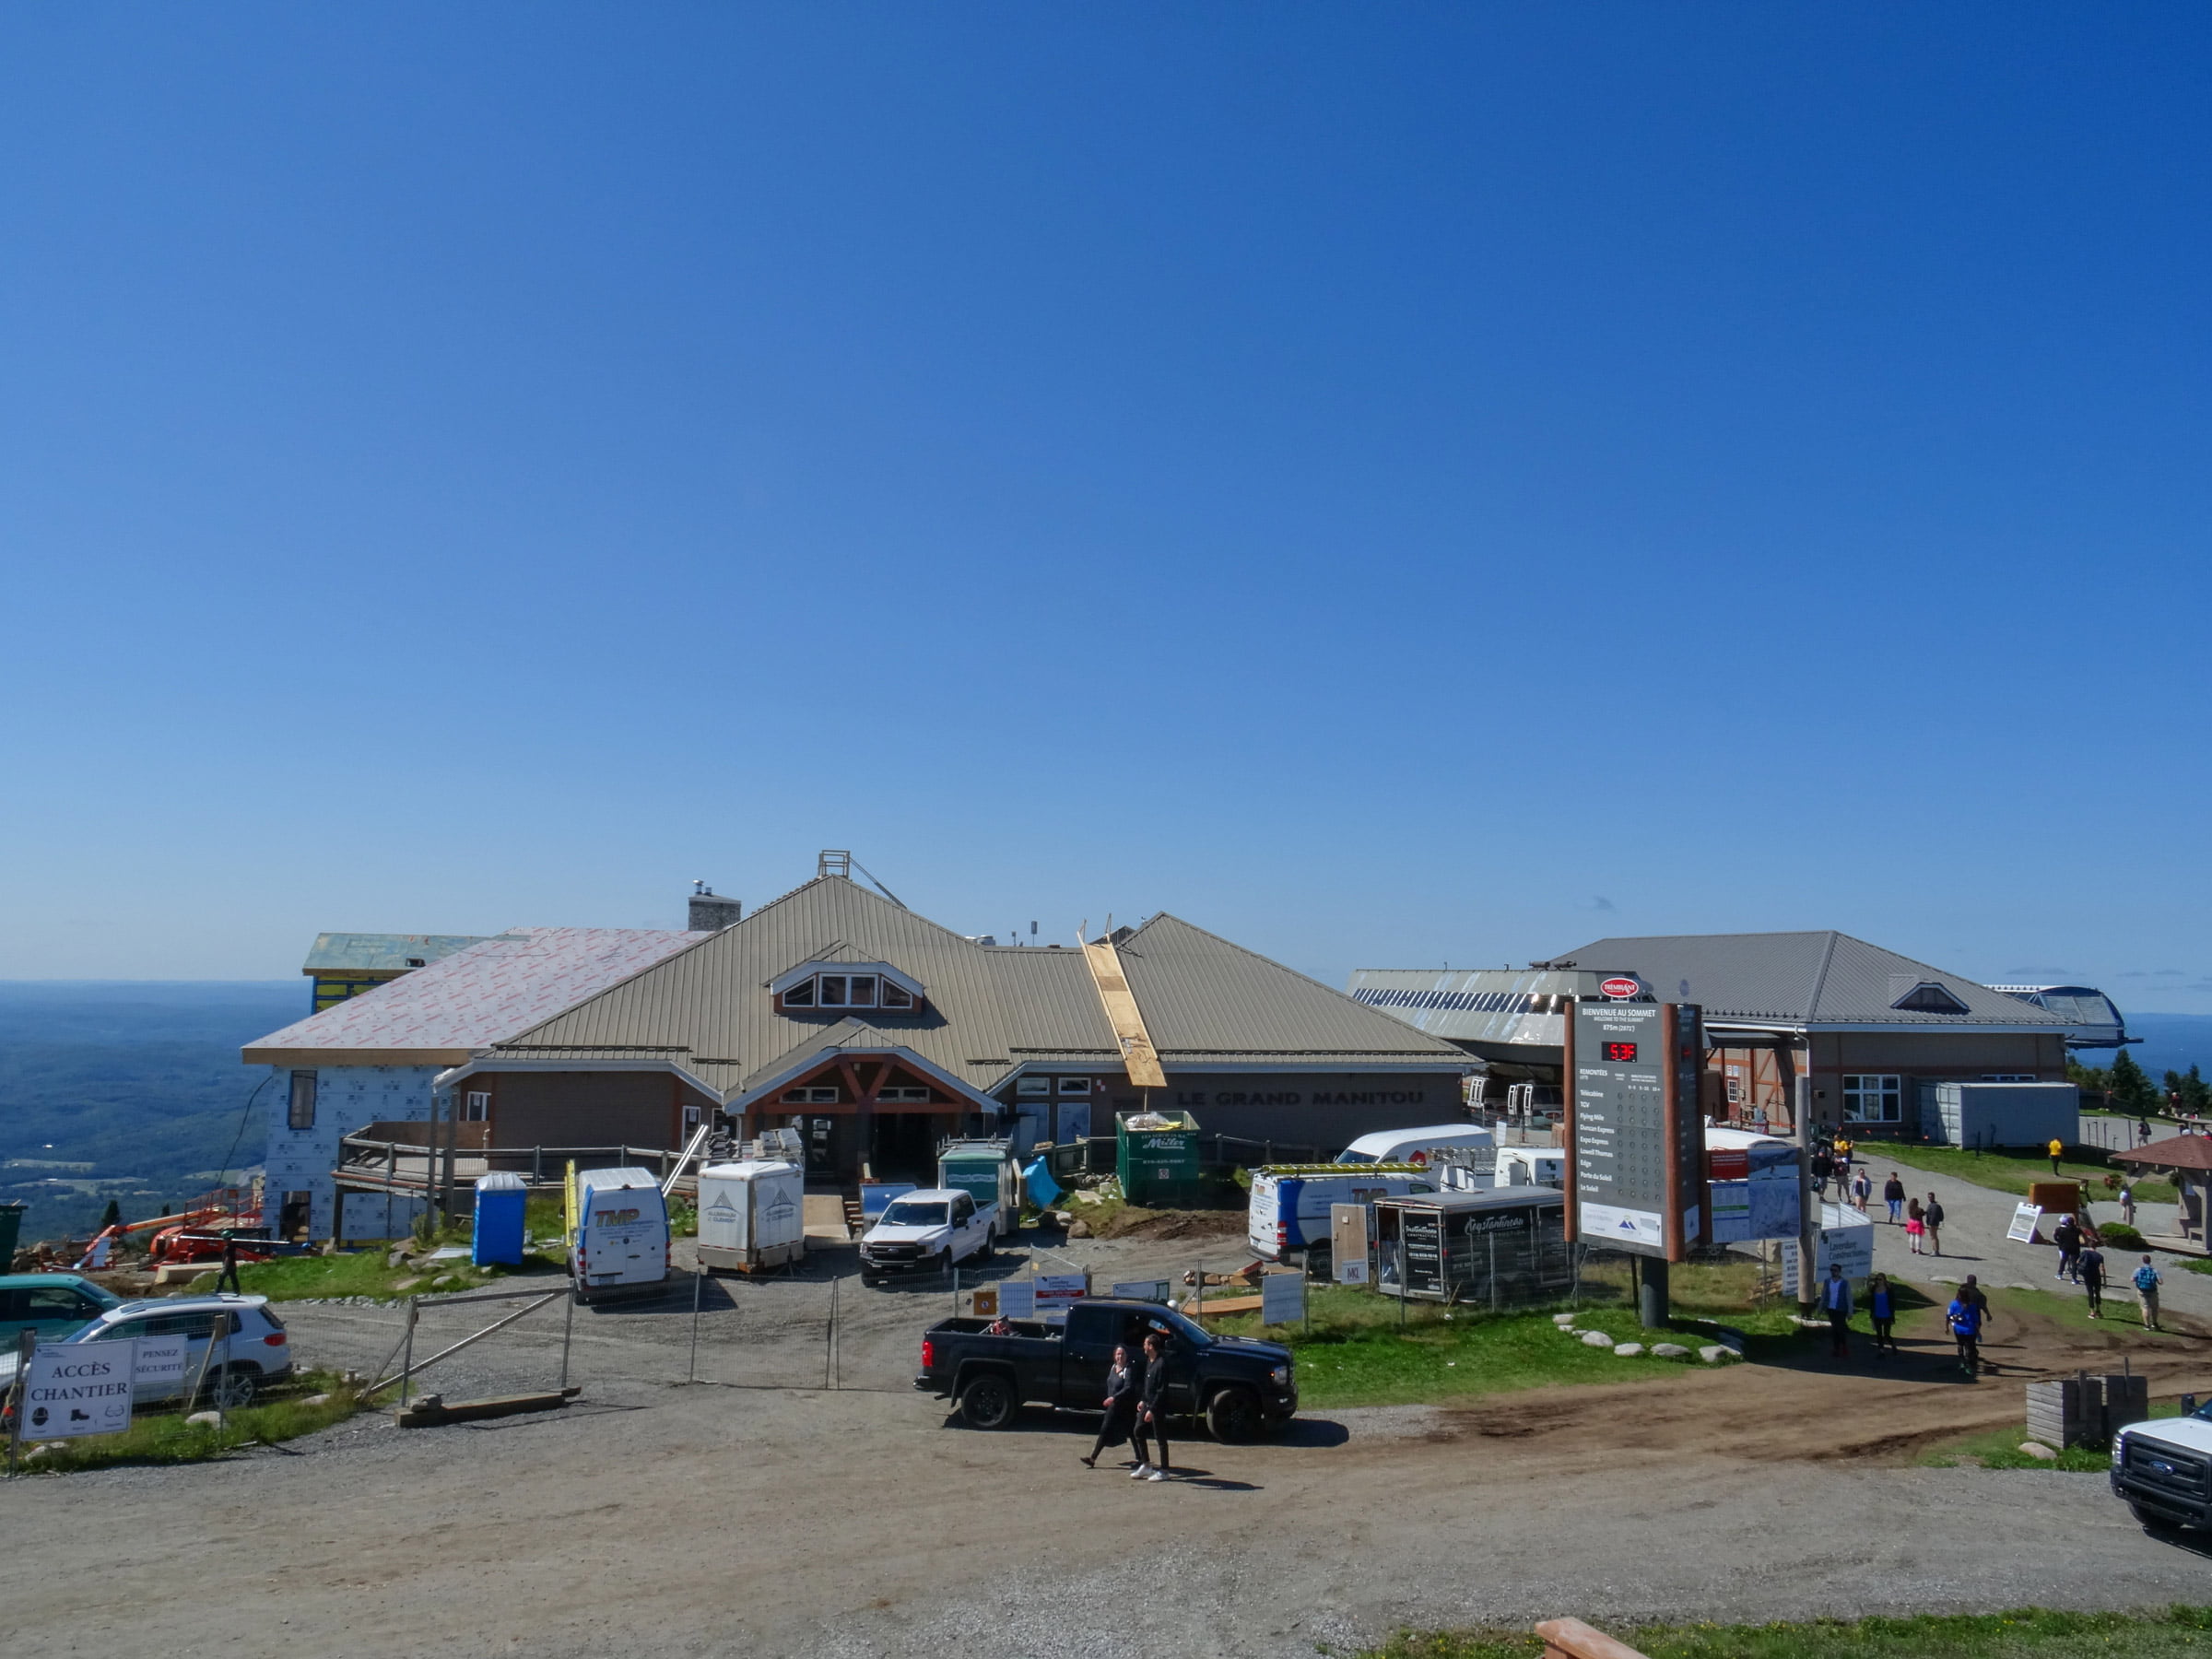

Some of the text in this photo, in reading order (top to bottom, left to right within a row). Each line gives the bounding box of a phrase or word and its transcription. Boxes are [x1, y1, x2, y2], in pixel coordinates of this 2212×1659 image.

[1178, 1091, 1424, 1105] LE GRAND MANITOU
[1580, 1112, 1594, 1121] Flying
[1597, 1126, 1615, 1135] Express
[1143, 1137, 1185, 1149] Miller
[1591, 1137, 1609, 1146] Express
[1580, 1147, 1614, 1158] Lowell Thomas
[1599, 1173, 1613, 1182] Soleil
[1586, 1184, 1599, 1193] Soleil
[595, 1208, 640, 1227] TMP
[142, 1348, 179, 1359] PENSEZ
[52, 1360, 112, 1379] ACCÈS
[135, 1362, 182, 1373] SÉCURITÉ
[31, 1382, 127, 1402] CHANTIER
